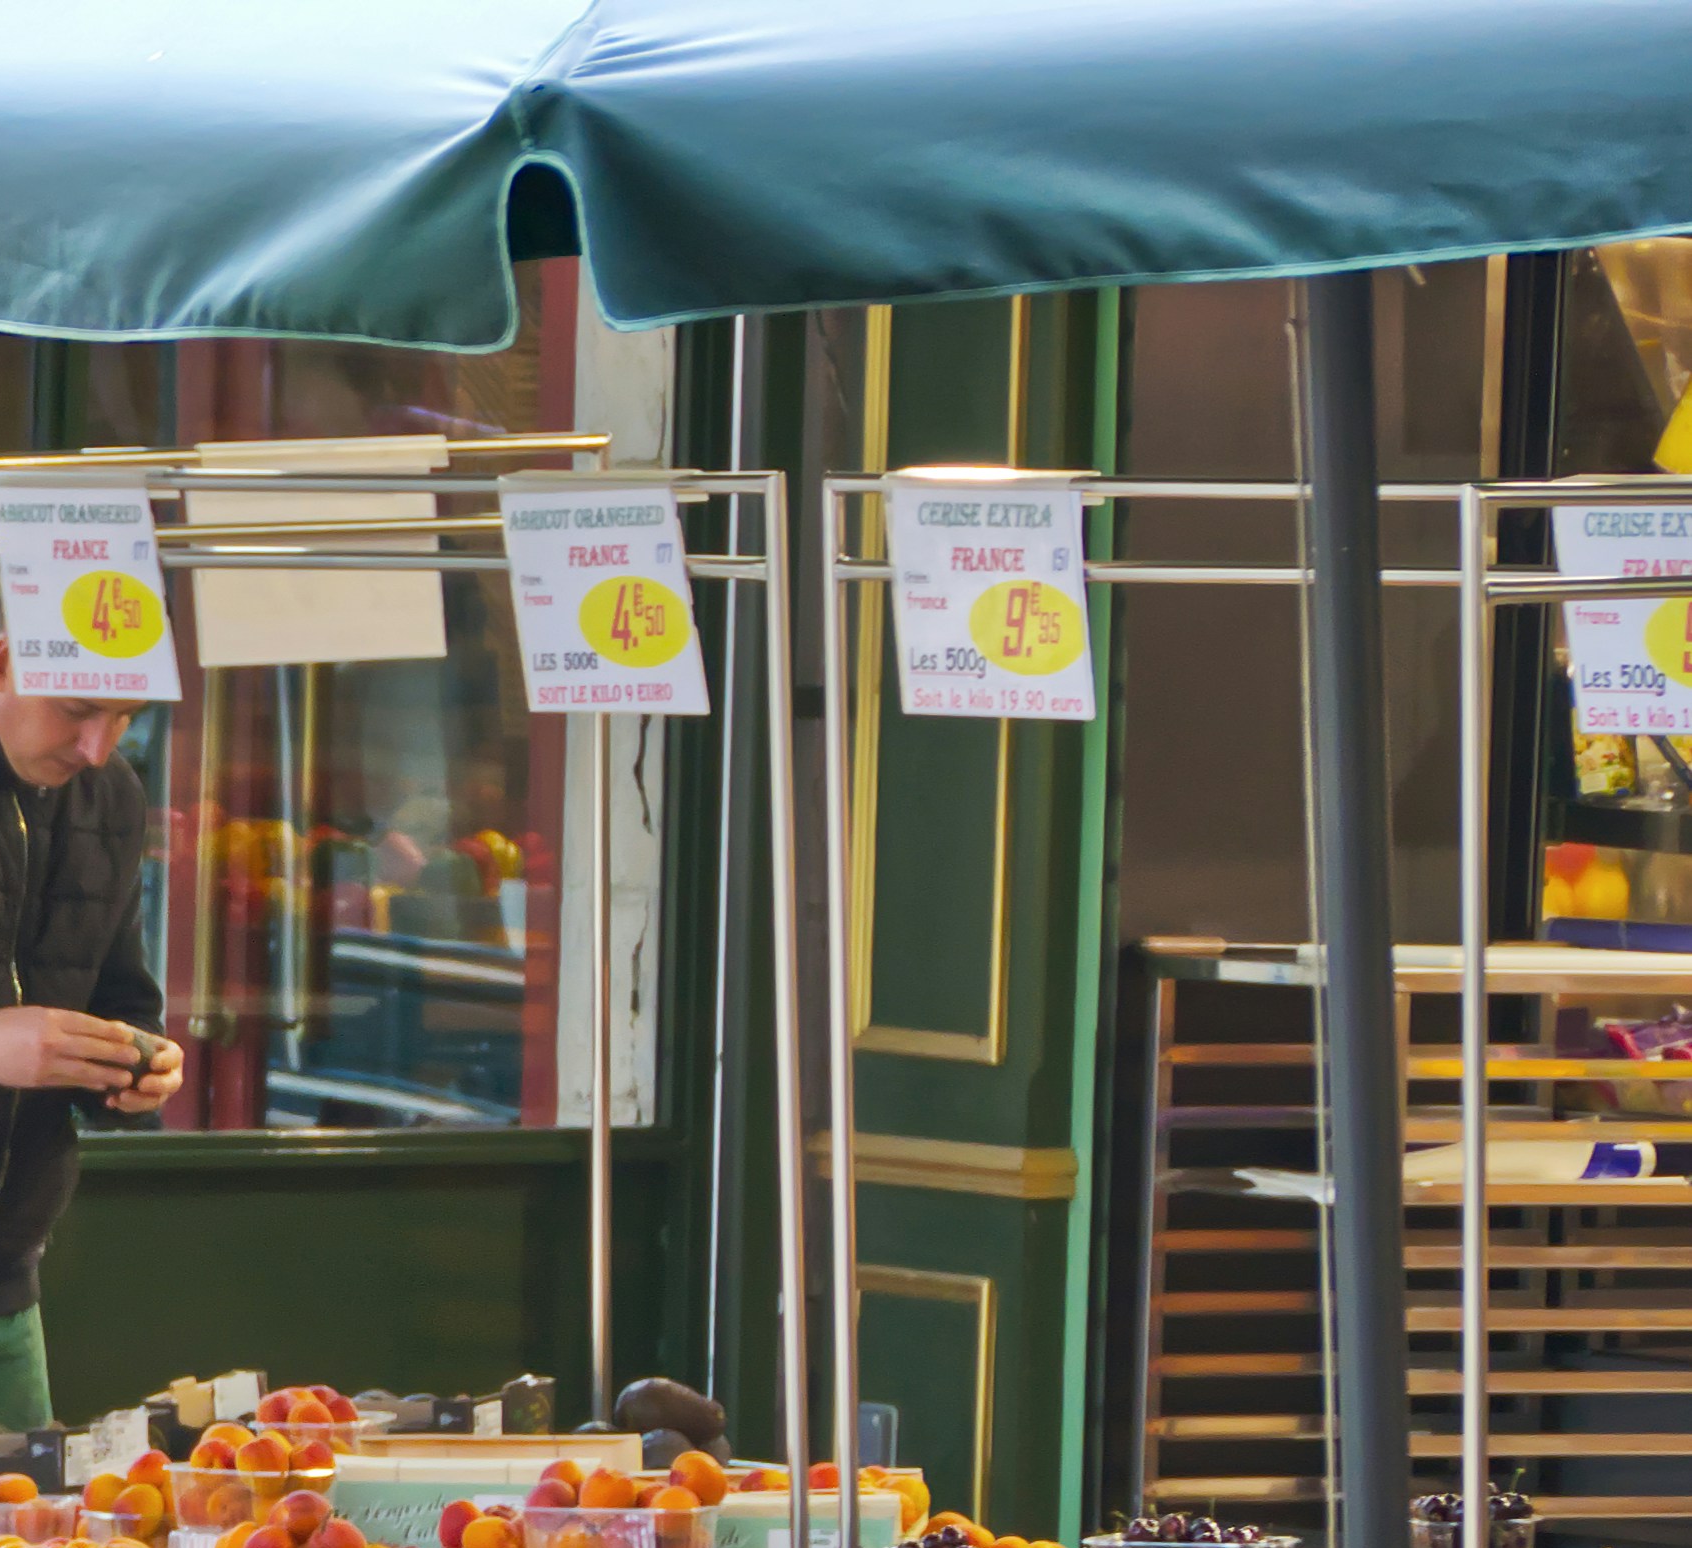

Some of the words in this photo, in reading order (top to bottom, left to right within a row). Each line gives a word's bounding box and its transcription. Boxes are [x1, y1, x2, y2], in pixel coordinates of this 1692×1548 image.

[58, 504, 142, 524] ORANGERED
[509, 509, 570, 531] ABRICOT
[574, 505, 665, 529] ORANGERED
[918, 501, 982, 527] CERISE
[987, 503, 1052, 529] EXTRA
[1583, 512, 1655, 537] CERISE
[52, 540, 110, 561] FRANCE
[568, 544, 630, 567] FRANCE
[951, 547, 1025, 572] FRANCE
[18, 640, 41, 658] LES
[533, 653, 557, 671] LES
[563, 652, 599, 671] 500G
[910, 647, 937, 670] Les
[945, 647, 987, 678] 500g
[22, 671, 51, 690] SOIT
[52, 672, 69, 690] LE
[71, 672, 101, 690] KILO
[103, 673, 112, 691] 9
[115, 673, 148, 691] EURO
[1581, 664, 1611, 688] Les
[1620, 665, 1665, 697] 500g
[537, 686, 568, 704] SOIT
[570, 685, 587, 703] LE
[591, 685, 622, 703] KILO
[624, 684, 633, 702] 9
[637, 683, 673, 701] EURO
[913, 688, 943, 708] Soit
[950, 688, 962, 708] le
[969, 689, 994, 709] kilo
[1001, 690, 1045, 711] 19.90
[1051, 696, 1083, 712] euro
[1587, 706, 1620, 727] Soit
[1626, 706, 1640, 727] le
[1648, 707, 1675, 728] kilo
